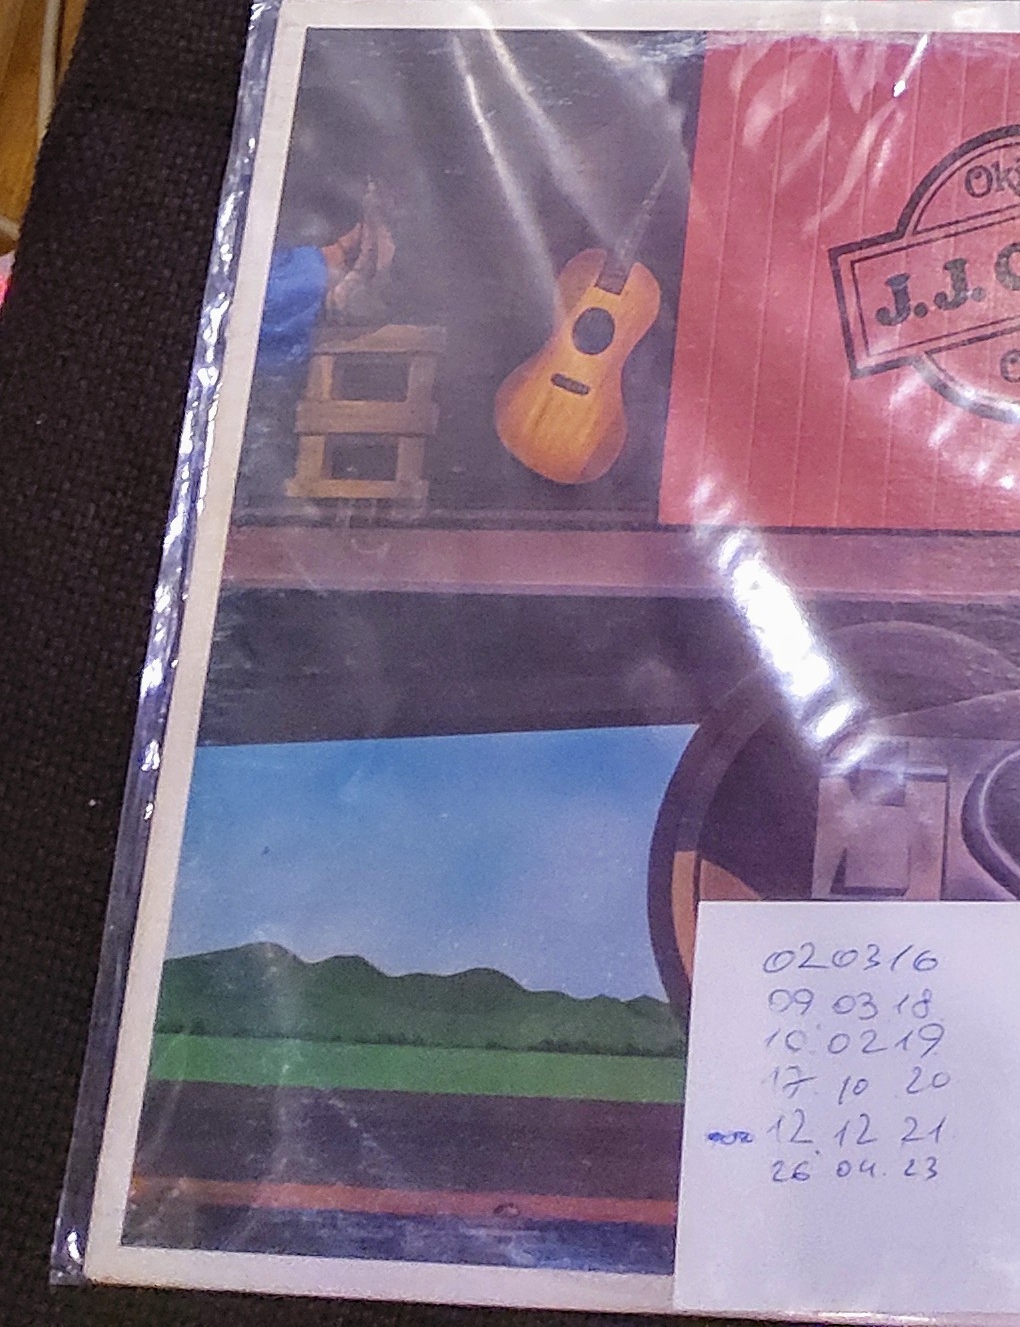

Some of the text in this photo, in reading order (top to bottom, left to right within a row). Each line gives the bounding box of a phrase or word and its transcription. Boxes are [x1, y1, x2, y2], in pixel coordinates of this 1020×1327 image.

[876, 257, 986, 326] J.J.
[769, 988, 814, 1016] 09
[832, 992, 878, 1020] 03
[838, 1076, 869, 1105] 10
[906, 1066, 951, 1095] 20
[767, 1109, 813, 1144] 12
[835, 1113, 878, 1146] 12
[901, 1116, 947, 1144] 21
[904, 1156, 938, 1180] 23
